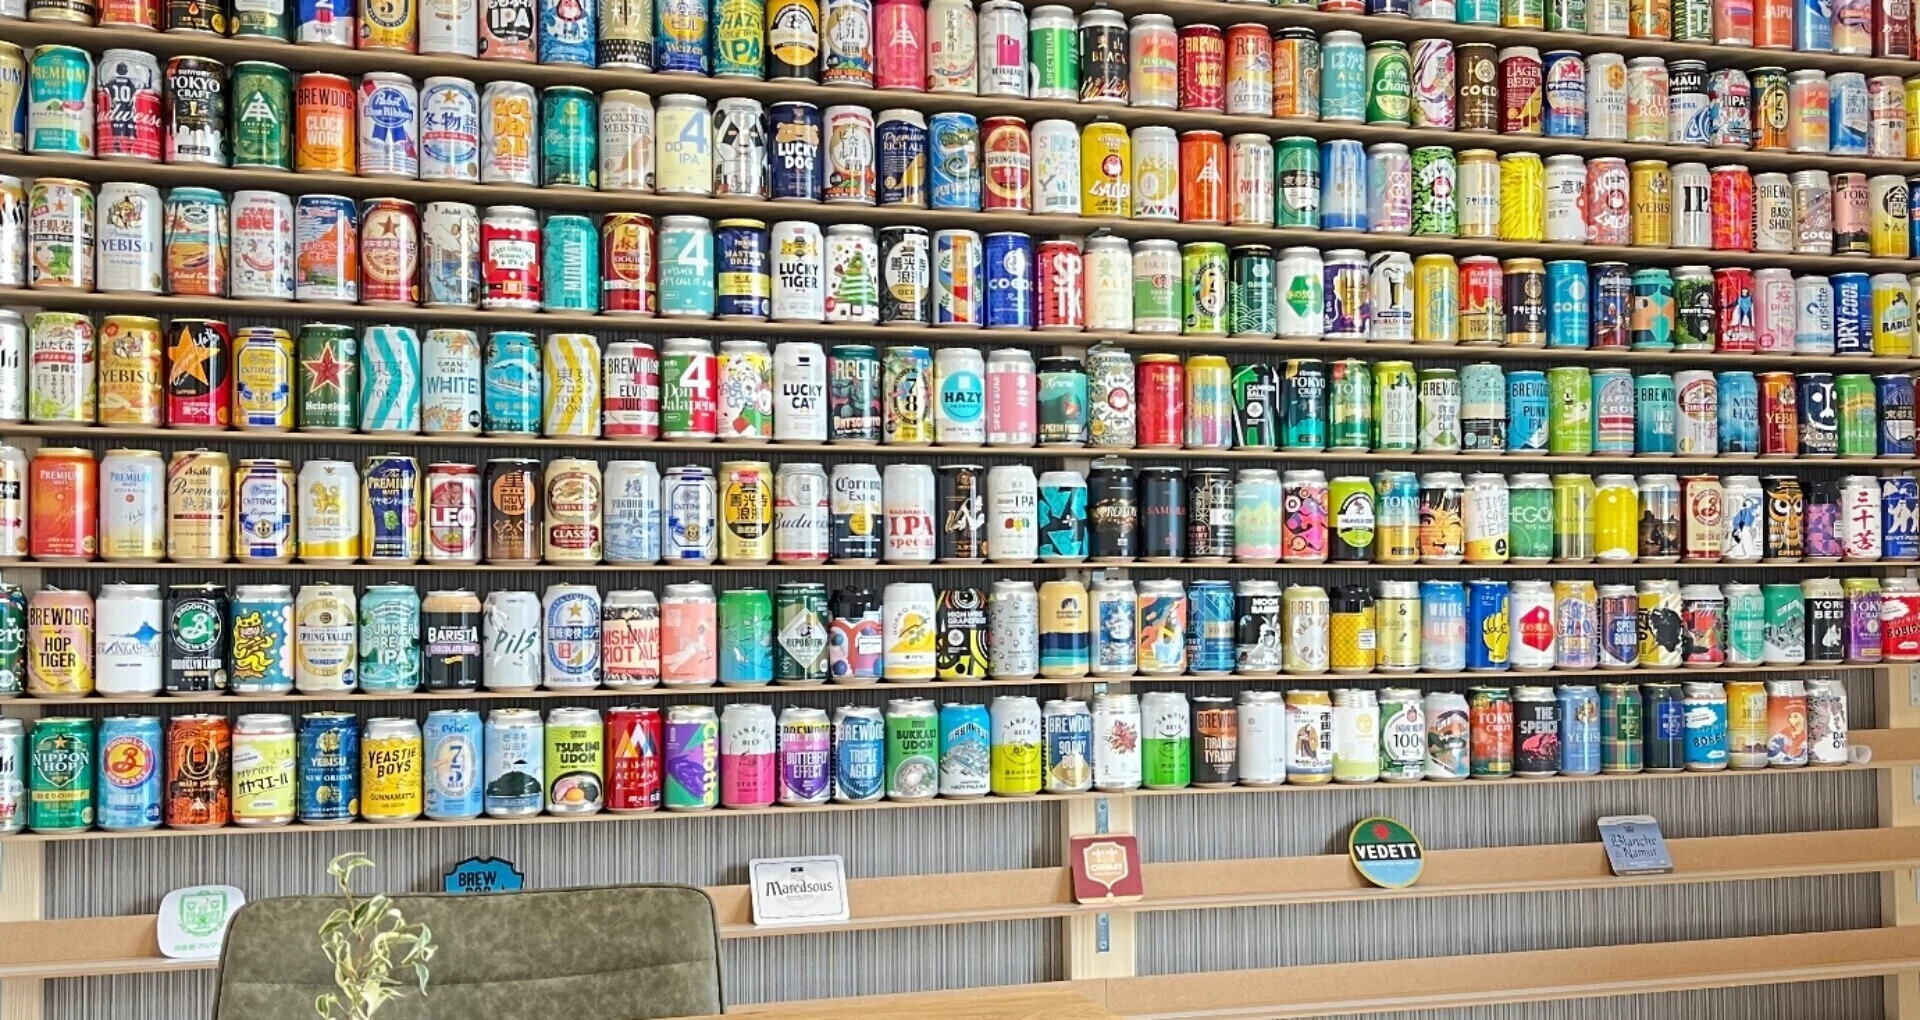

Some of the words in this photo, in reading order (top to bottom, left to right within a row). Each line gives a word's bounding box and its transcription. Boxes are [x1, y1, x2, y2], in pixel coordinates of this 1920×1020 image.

[491, 8, 531, 28] IPA
[1046, 32, 1055, 86] SPECTRUM
[1506, 66, 1542, 78] LAGER
[169, 77, 222, 92] TOKYO
[1375, 78, 1411, 94] Chang
[1506, 77, 1537, 88] BEER
[1669, 74, 1701, 88] MAUI
[112, 86, 131, 103] 10
[177, 88, 213, 99] CRAFT
[299, 87, 353, 110] BREWDOG
[373, 95, 401, 108] Pabst
[305, 117, 340, 134] CLOCK
[603, 113, 649, 124] GOLDEN
[603, 123, 650, 136] MEISTER
[679, 112, 707, 153] 4
[306, 131, 340, 147] WORK
[778, 142, 818, 157] LUCKY
[679, 154, 700, 166] IPA
[784, 156, 815, 171] DOG
[102, 238, 154, 254] YEBISU
[677, 230, 708, 277] 4
[563, 239, 583, 292] MIDWAY
[779, 262, 818, 276] LUCKY
[780, 276, 818, 289] TIGER
[1838, 282, 1858, 317] COOL
[1821, 287, 1830, 330] grisette
[1837, 319, 1859, 349] DRY
[437, 360, 470, 369] GRAND
[608, 357, 659, 375] BREWDOG
[102, 368, 159, 385] YEBISU
[679, 354, 712, 399] 4
[1291, 375, 1326, 389] TOKYO
[426, 376, 480, 396] WHITE
[619, 384, 648, 398] ELVIS
[783, 383, 823, 397] LUCKY
[556, 393, 593, 404] TOKYO
[618, 398, 647, 412] JUICE
[791, 396, 818, 410] CAT
[944, 391, 983, 404] HAZY
[993, 375, 1001, 429] SPECTRUM
[304, 400, 350, 412] Heineken
[556, 403, 593, 415] BLONDE
[183, 467, 213, 477] Asahi
[368, 476, 415, 489] PREMIUM
[835, 476, 882, 493] Corona
[848, 490, 876, 502] Extra
[1383, 495, 1420, 508] TOKYO
[429, 507, 476, 528] LEO
[889, 515, 934, 538] IPA
[552, 529, 596, 541] CLASSIC
[889, 536, 934, 549] special
[29, 606, 90, 626] BREWDOG
[175, 602, 217, 618] BROOKLYN
[1429, 602, 1463, 617] WHITE
[365, 621, 419, 637] SUMMER
[427, 625, 479, 643] BARISTA
[44, 636, 72, 652] HOP
[176, 637, 214, 651] BREWERY
[493, 628, 536, 655] Pils
[39, 651, 76, 668] TIGER
[377, 648, 408, 665] IPA
[1534, 707, 1554, 720] THE
[554, 742, 600, 754] TSUKIMI
[902, 739, 935, 751] UDON
[33, 752, 89, 765] NIPPON
[310, 756, 347, 767] YEBISU
[367, 746, 418, 770] YEASTIE
[449, 745, 463, 763] 7
[559, 753, 597, 765] UDON
[786, 750, 829, 766] BUTTERFLY
[849, 748, 877, 763] TRIPLE
[43, 761, 77, 773] HOP
[376, 760, 412, 778] BOYS
[703, 718, 718, 807] Culotte
[305, 774, 323, 783] NEW
[325, 773, 353, 783] ORIGIN
[448, 764, 462, 784] 5
[793, 764, 822, 778] EFFECT
[849, 763, 877, 778] AGENT
[369, 791, 416, 802] GUNNAMATTA
[1609, 832, 1657, 848] Blanche
[1354, 843, 1418, 860] VEDETT
[1624, 846, 1657, 859] Namur
[459, 872, 497, 887] BREW
[765, 878, 834, 898] Maredsous
